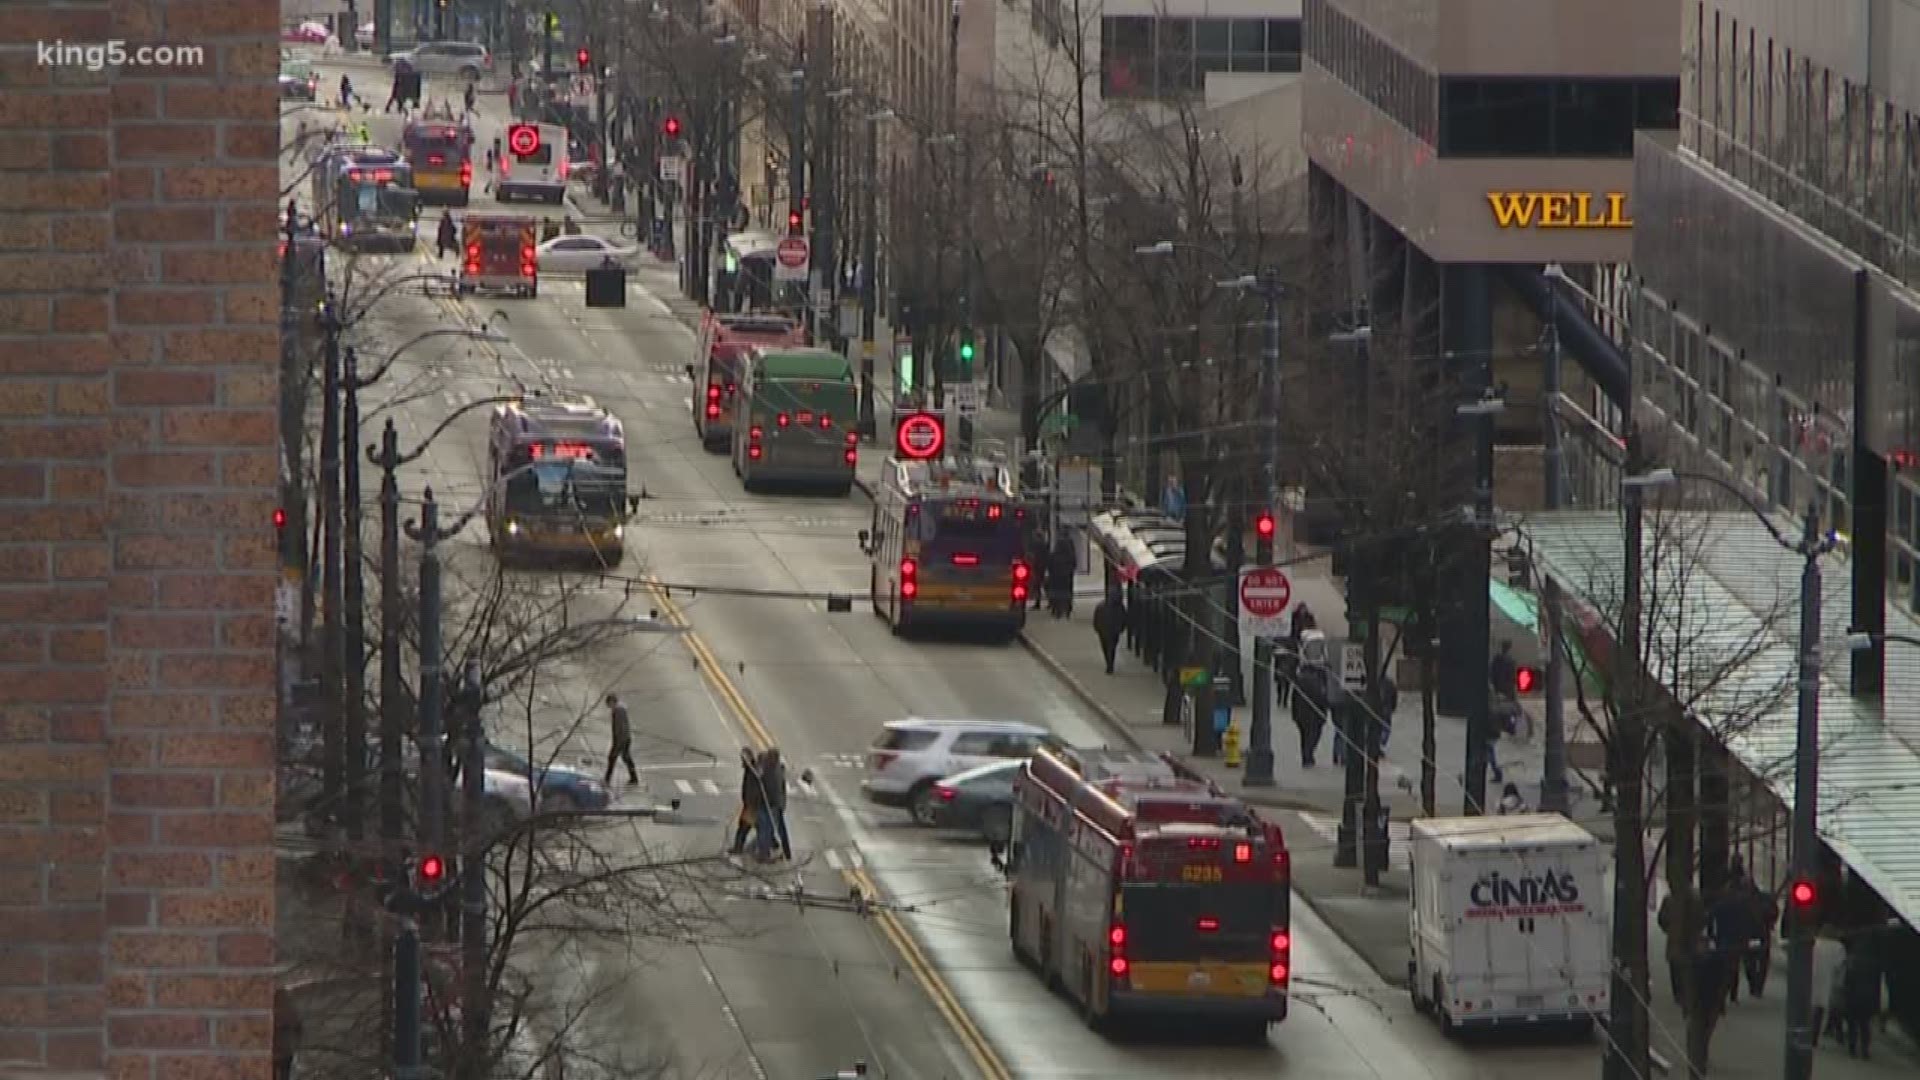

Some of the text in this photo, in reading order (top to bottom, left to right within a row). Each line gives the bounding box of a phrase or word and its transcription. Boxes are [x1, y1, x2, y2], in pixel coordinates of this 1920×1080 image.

[1487, 192, 1633, 228] WELL
[1250, 599, 1280, 609] ENTER
[1470, 867, 1579, 906] CINTAS
